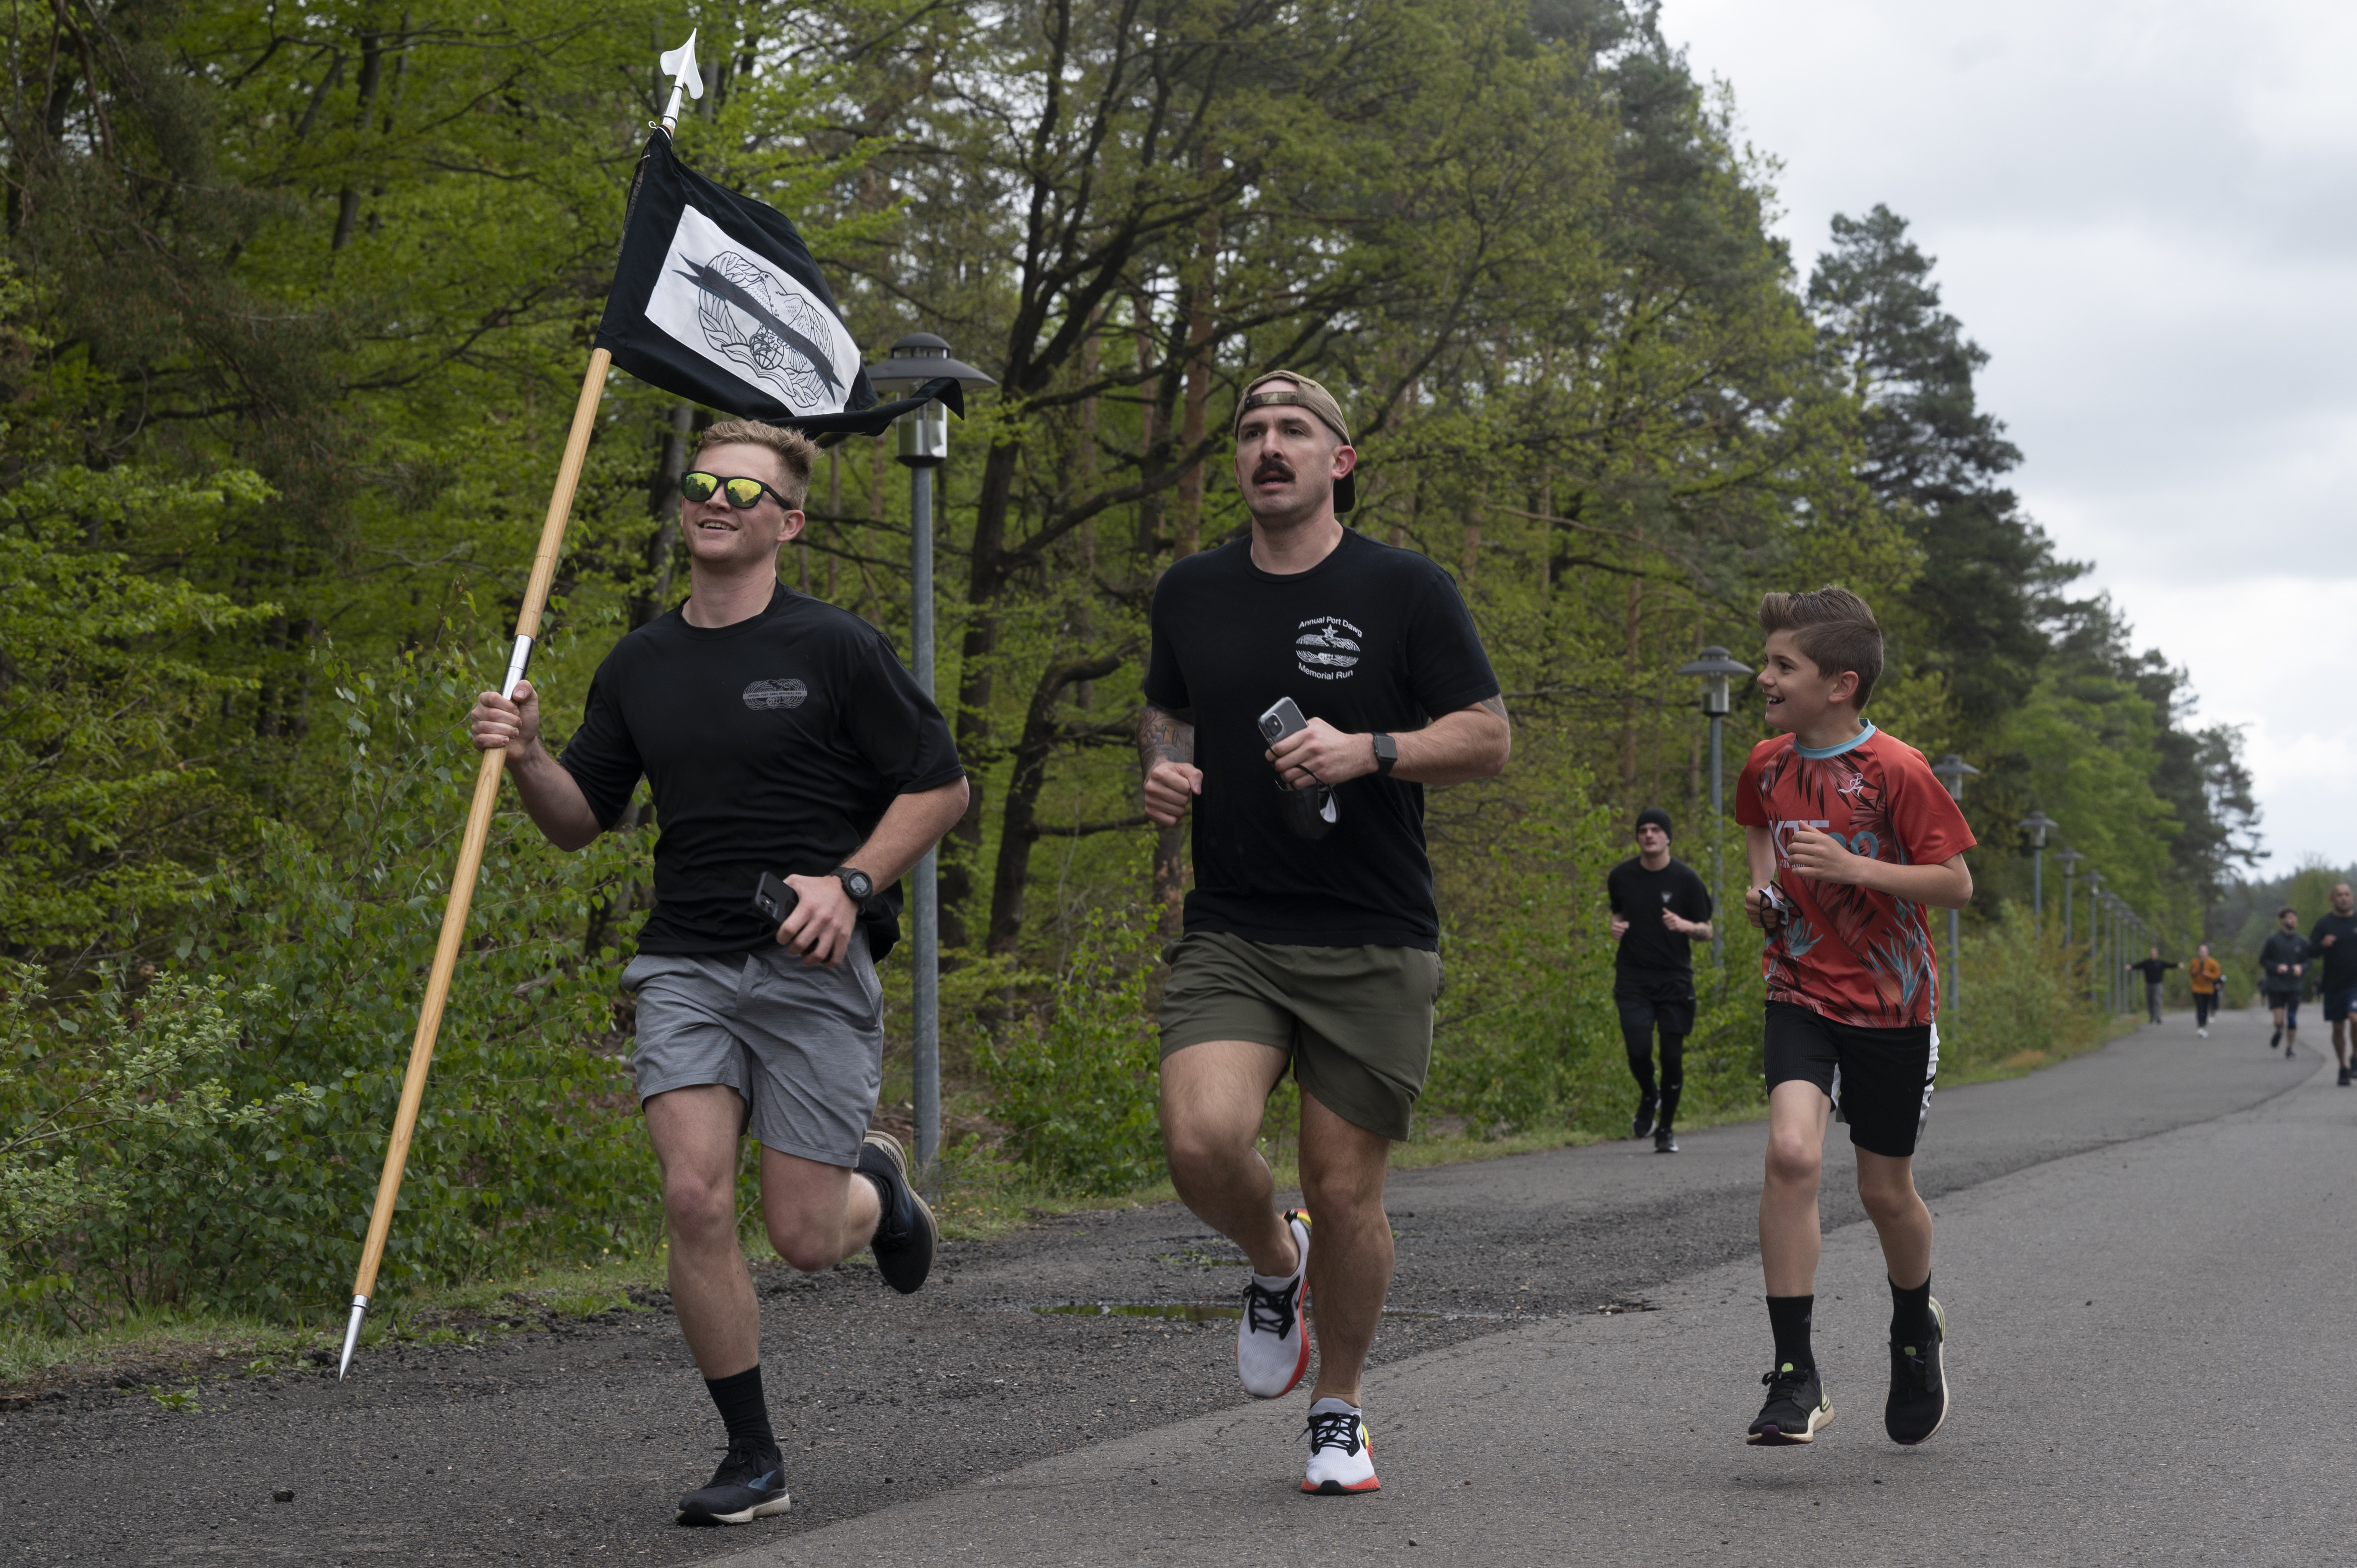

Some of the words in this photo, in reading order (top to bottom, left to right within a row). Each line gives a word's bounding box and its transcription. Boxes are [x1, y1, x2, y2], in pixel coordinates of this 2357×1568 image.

[1298, 616, 1325, 629] Annual
[1326, 616, 1341, 626] Port
[1343, 619, 1363, 638] Dawg
[1298, 662, 1334, 680] Memorial
[1336, 670, 1353, 680] Run
